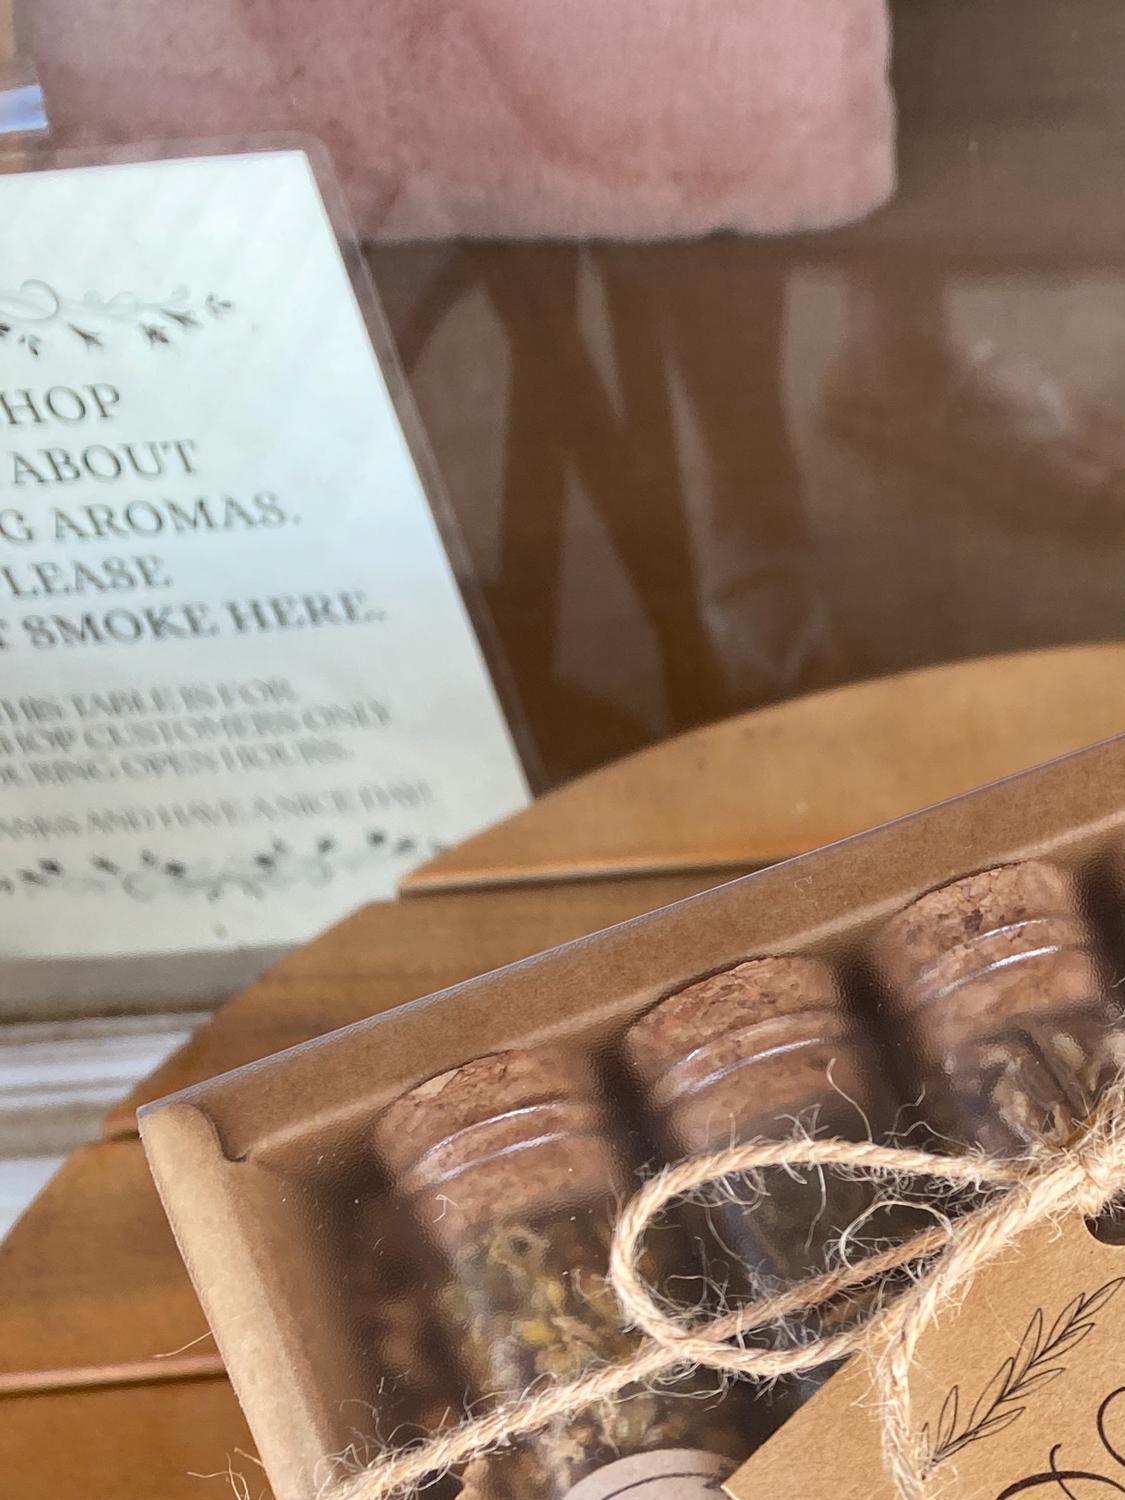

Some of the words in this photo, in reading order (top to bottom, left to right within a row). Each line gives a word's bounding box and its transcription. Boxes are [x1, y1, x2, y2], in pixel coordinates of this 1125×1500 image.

[0, 383, 120, 425] HOP
[10, 438, 199, 488] ABOUT
[52, 490, 302, 541] AROMAS.
[0, 555, 172, 597] LEASE
[21, 600, 220, 650] SMOKE
[222, 592, 389, 634] HERE.
